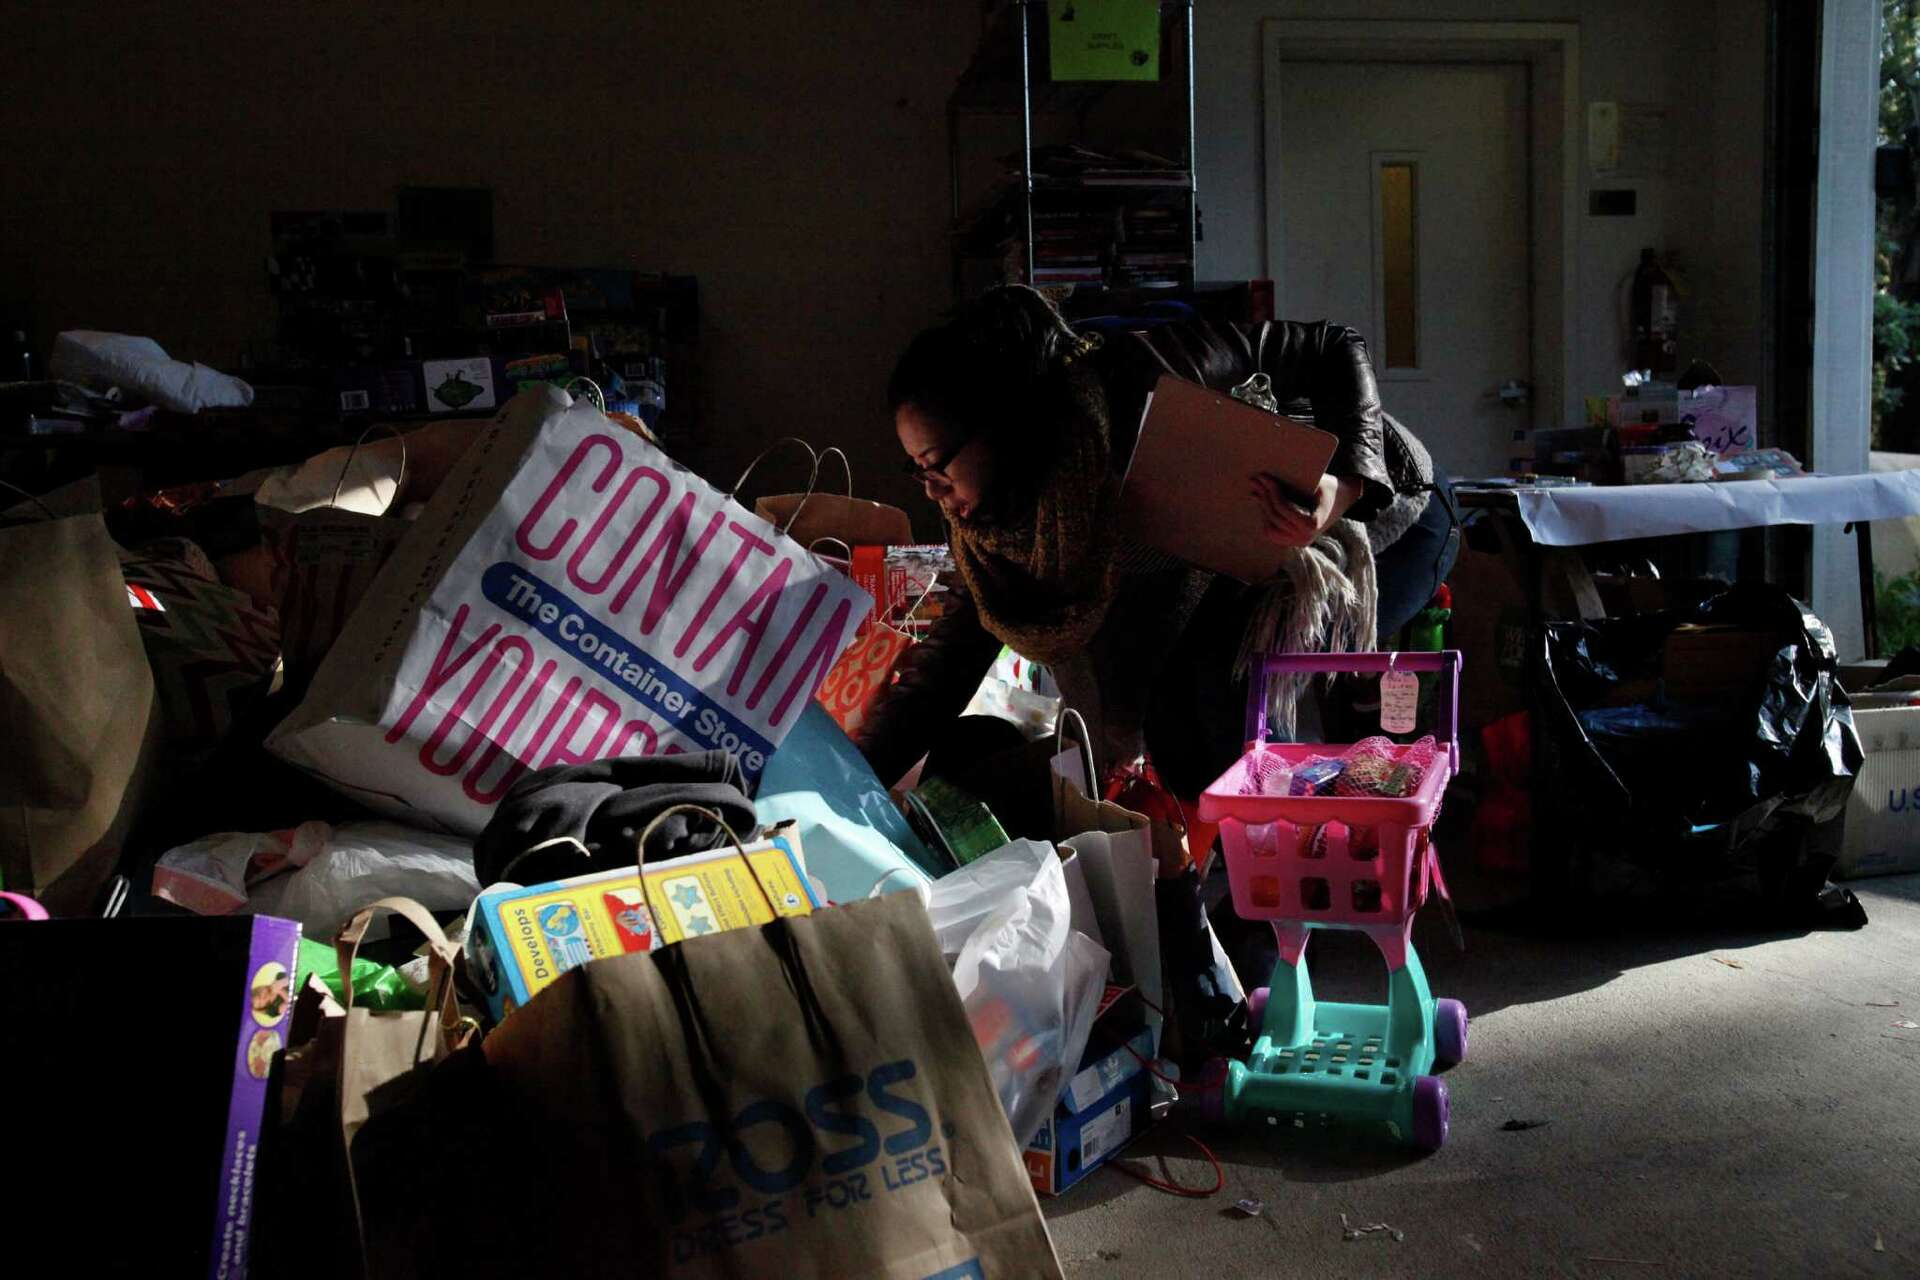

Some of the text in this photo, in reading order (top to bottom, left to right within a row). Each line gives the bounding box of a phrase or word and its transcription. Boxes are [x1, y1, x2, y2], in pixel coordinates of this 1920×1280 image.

[515, 434, 852, 727] CONTAIN
[504, 573, 766, 772] The Container Store
[514, 908, 550, 980] Develops
[227, 1130, 247, 1217] necklaces
[233, 1144, 258, 1266] and bracelets
[671, 1147, 946, 1266] DRESS FOR LESS
